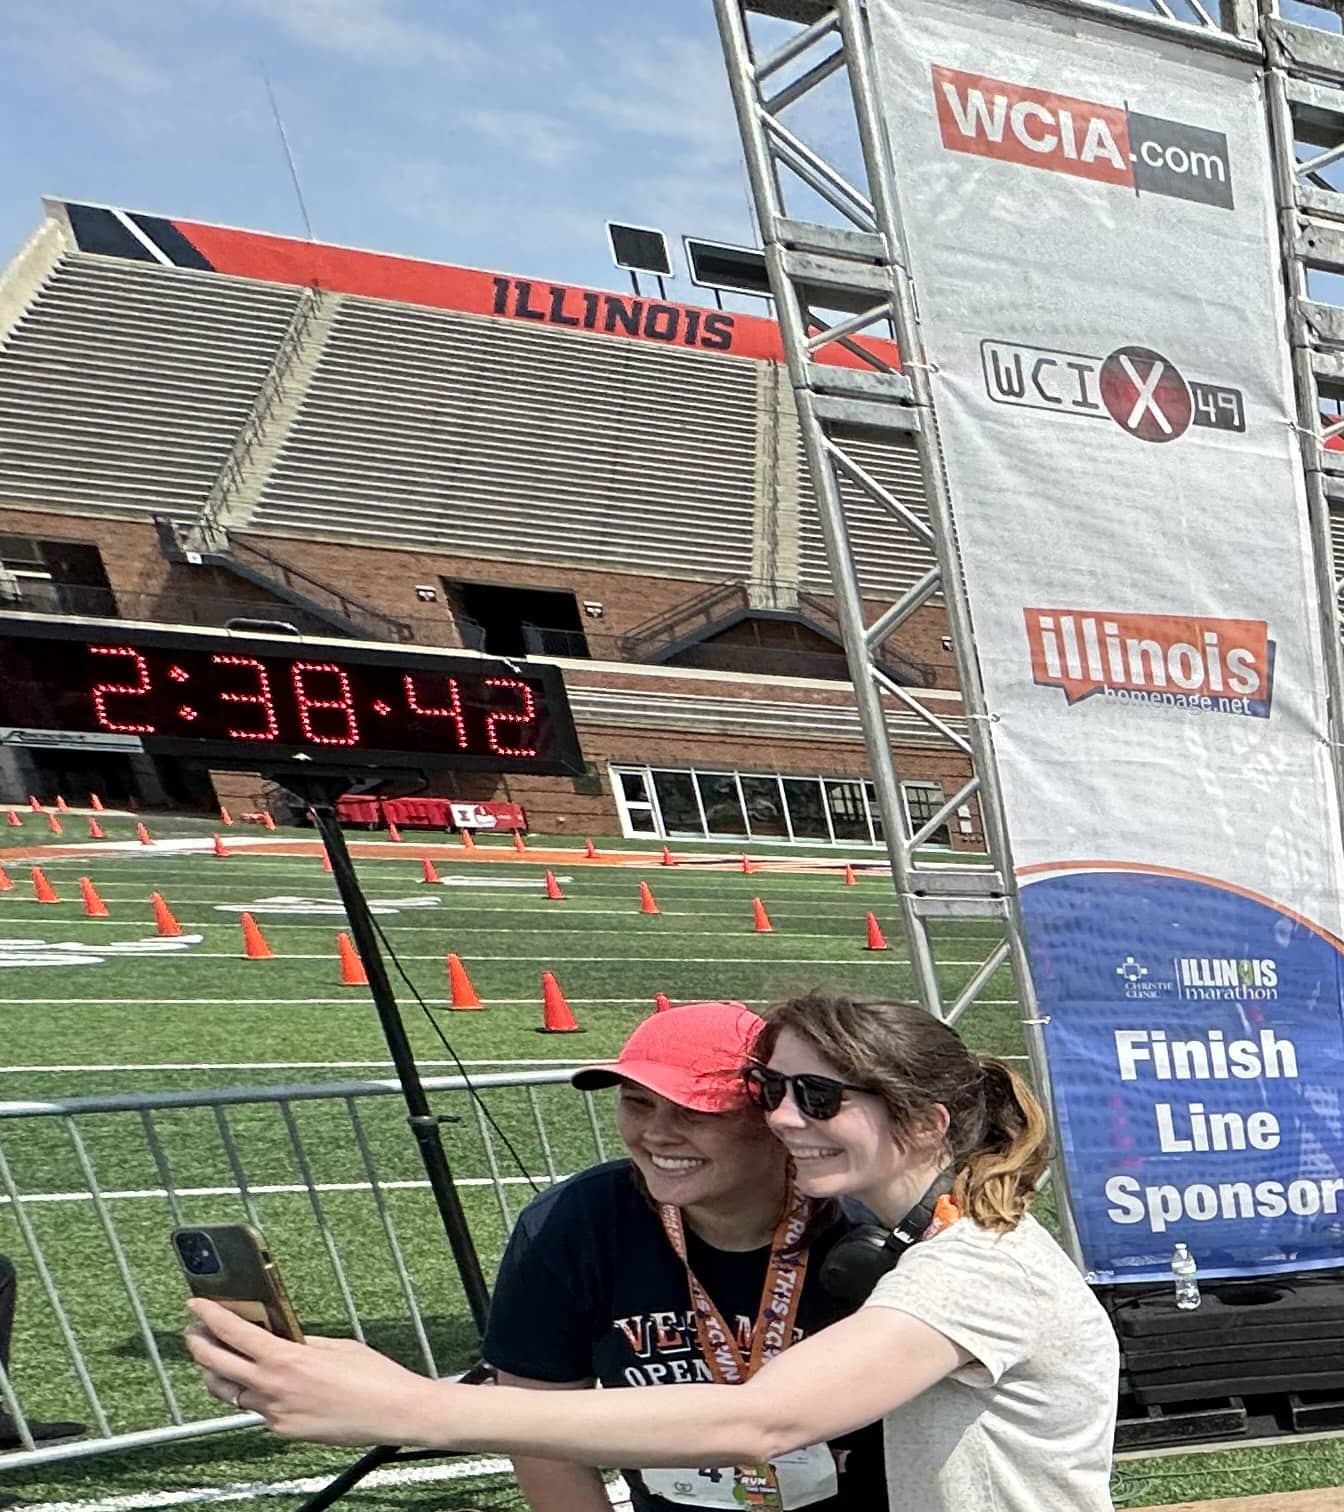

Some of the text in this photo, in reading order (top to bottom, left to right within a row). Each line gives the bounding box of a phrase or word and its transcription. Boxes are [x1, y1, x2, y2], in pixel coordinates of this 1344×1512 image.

[941, 81, 1227, 184] WCIA.com
[492, 276, 736, 353] ILLINOIS
[1037, 613, 1262, 695] illinois
[1185, 985, 1279, 1001] marathon
[1113, 1029, 1299, 1081] Finish
[1154, 1102, 1282, 1154] Line
[1104, 1175, 1344, 1233] Sponsor
